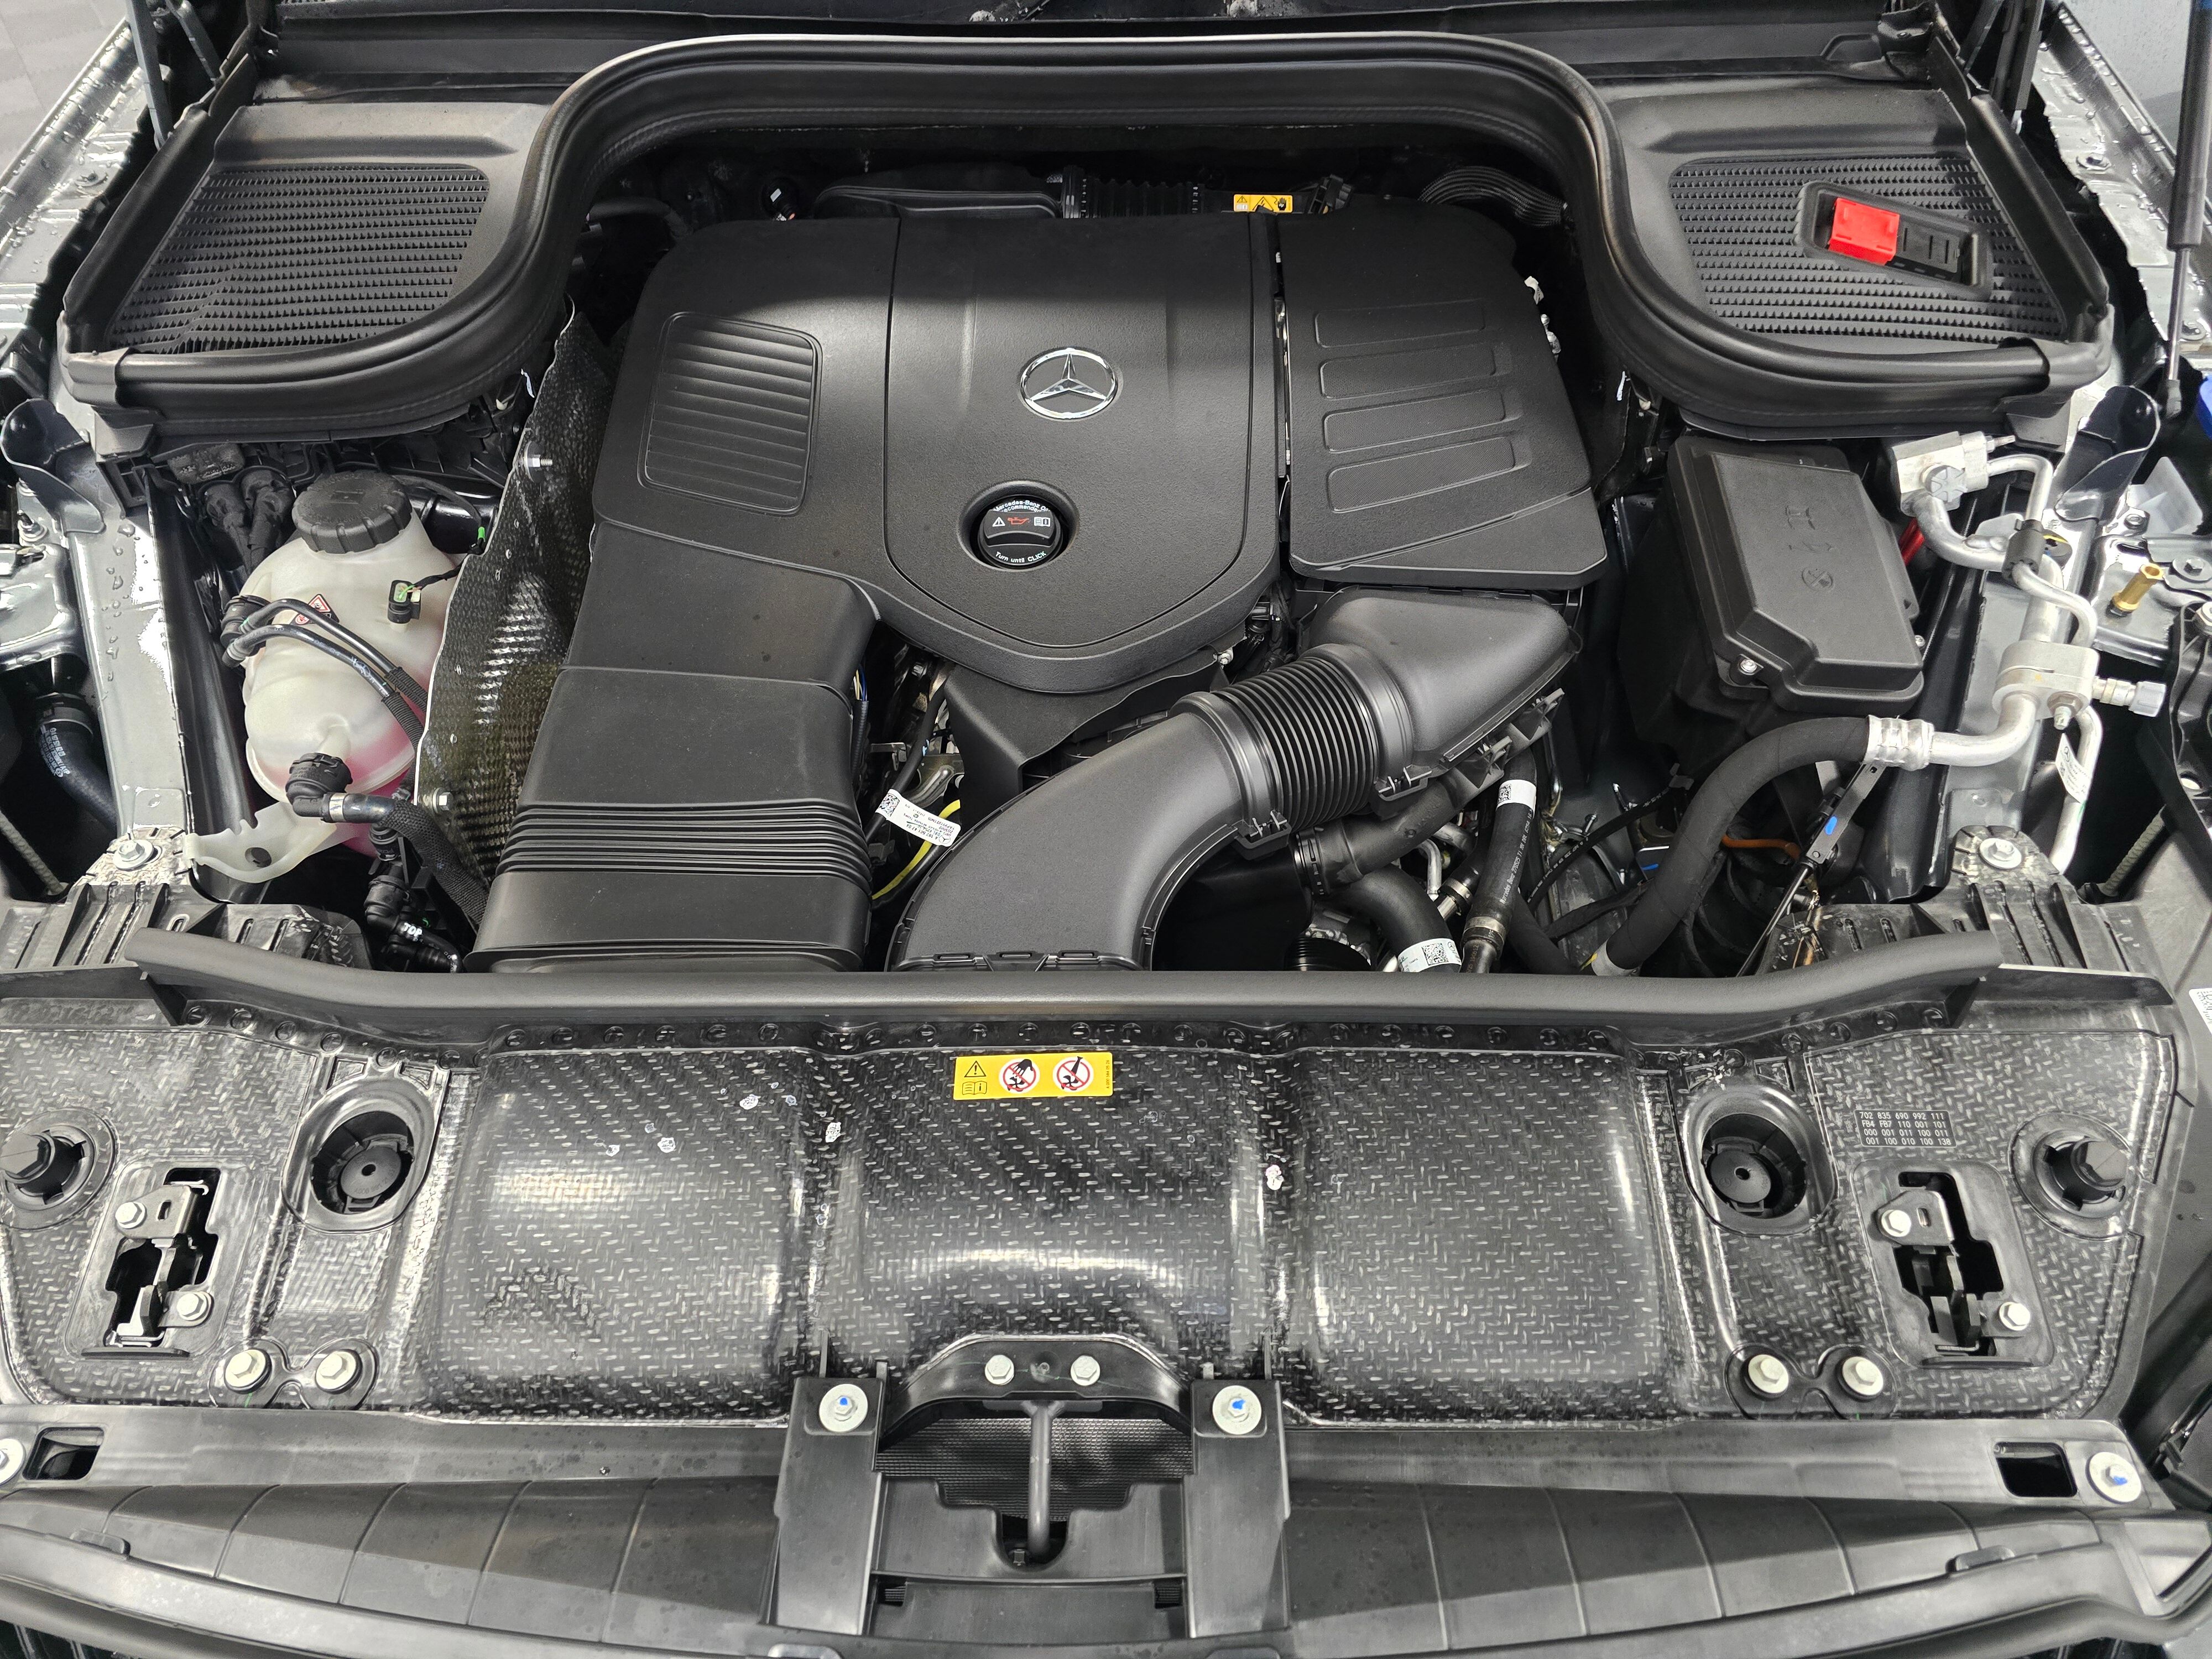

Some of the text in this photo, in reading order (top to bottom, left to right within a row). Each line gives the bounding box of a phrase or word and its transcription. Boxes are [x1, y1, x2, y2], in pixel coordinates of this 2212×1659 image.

[1000, 504, 1042, 513] ecommende
[996, 551, 1009, 561] Turn
[1027, 551, 1047, 562] CLICK
[404, 922, 422, 937] TOP
